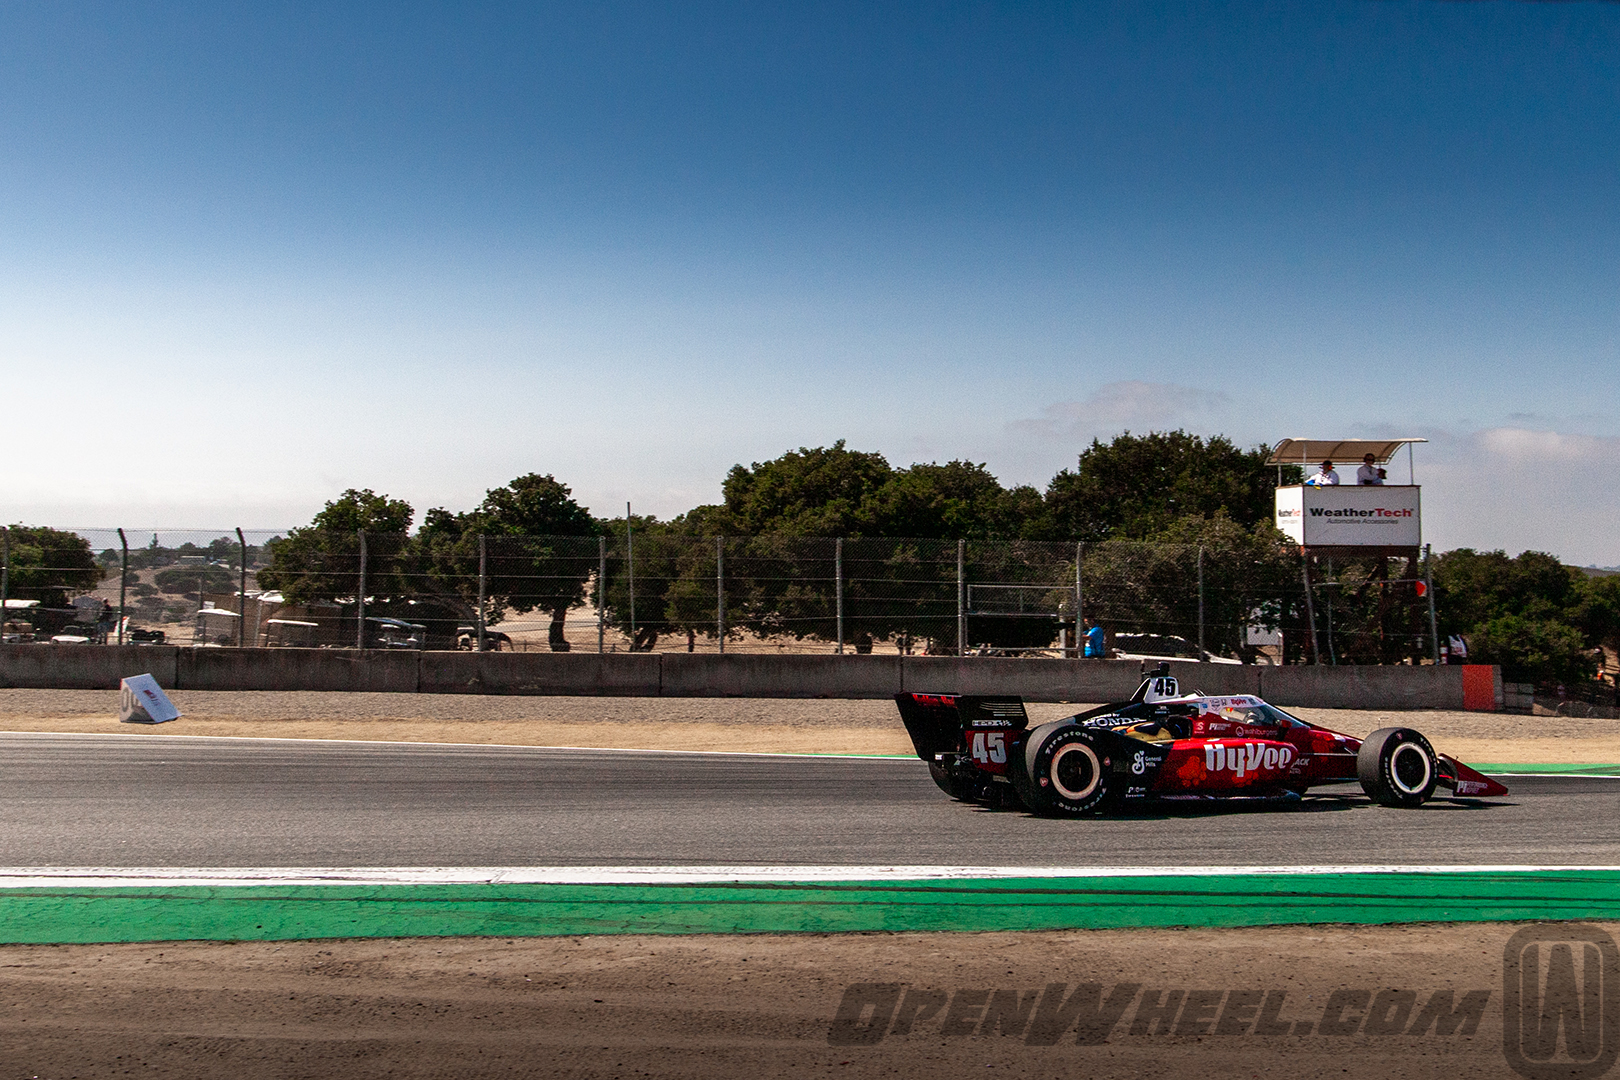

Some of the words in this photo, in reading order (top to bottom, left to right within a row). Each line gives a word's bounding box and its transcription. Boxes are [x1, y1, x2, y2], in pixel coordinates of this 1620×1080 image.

[1309, 507, 1412, 518] WeatherTech
[1154, 678, 1176, 697] 45
[1081, 716, 1147, 727] HONDA
[972, 732, 1007, 764] 45
[1044, 730, 1095, 755] Firestone
